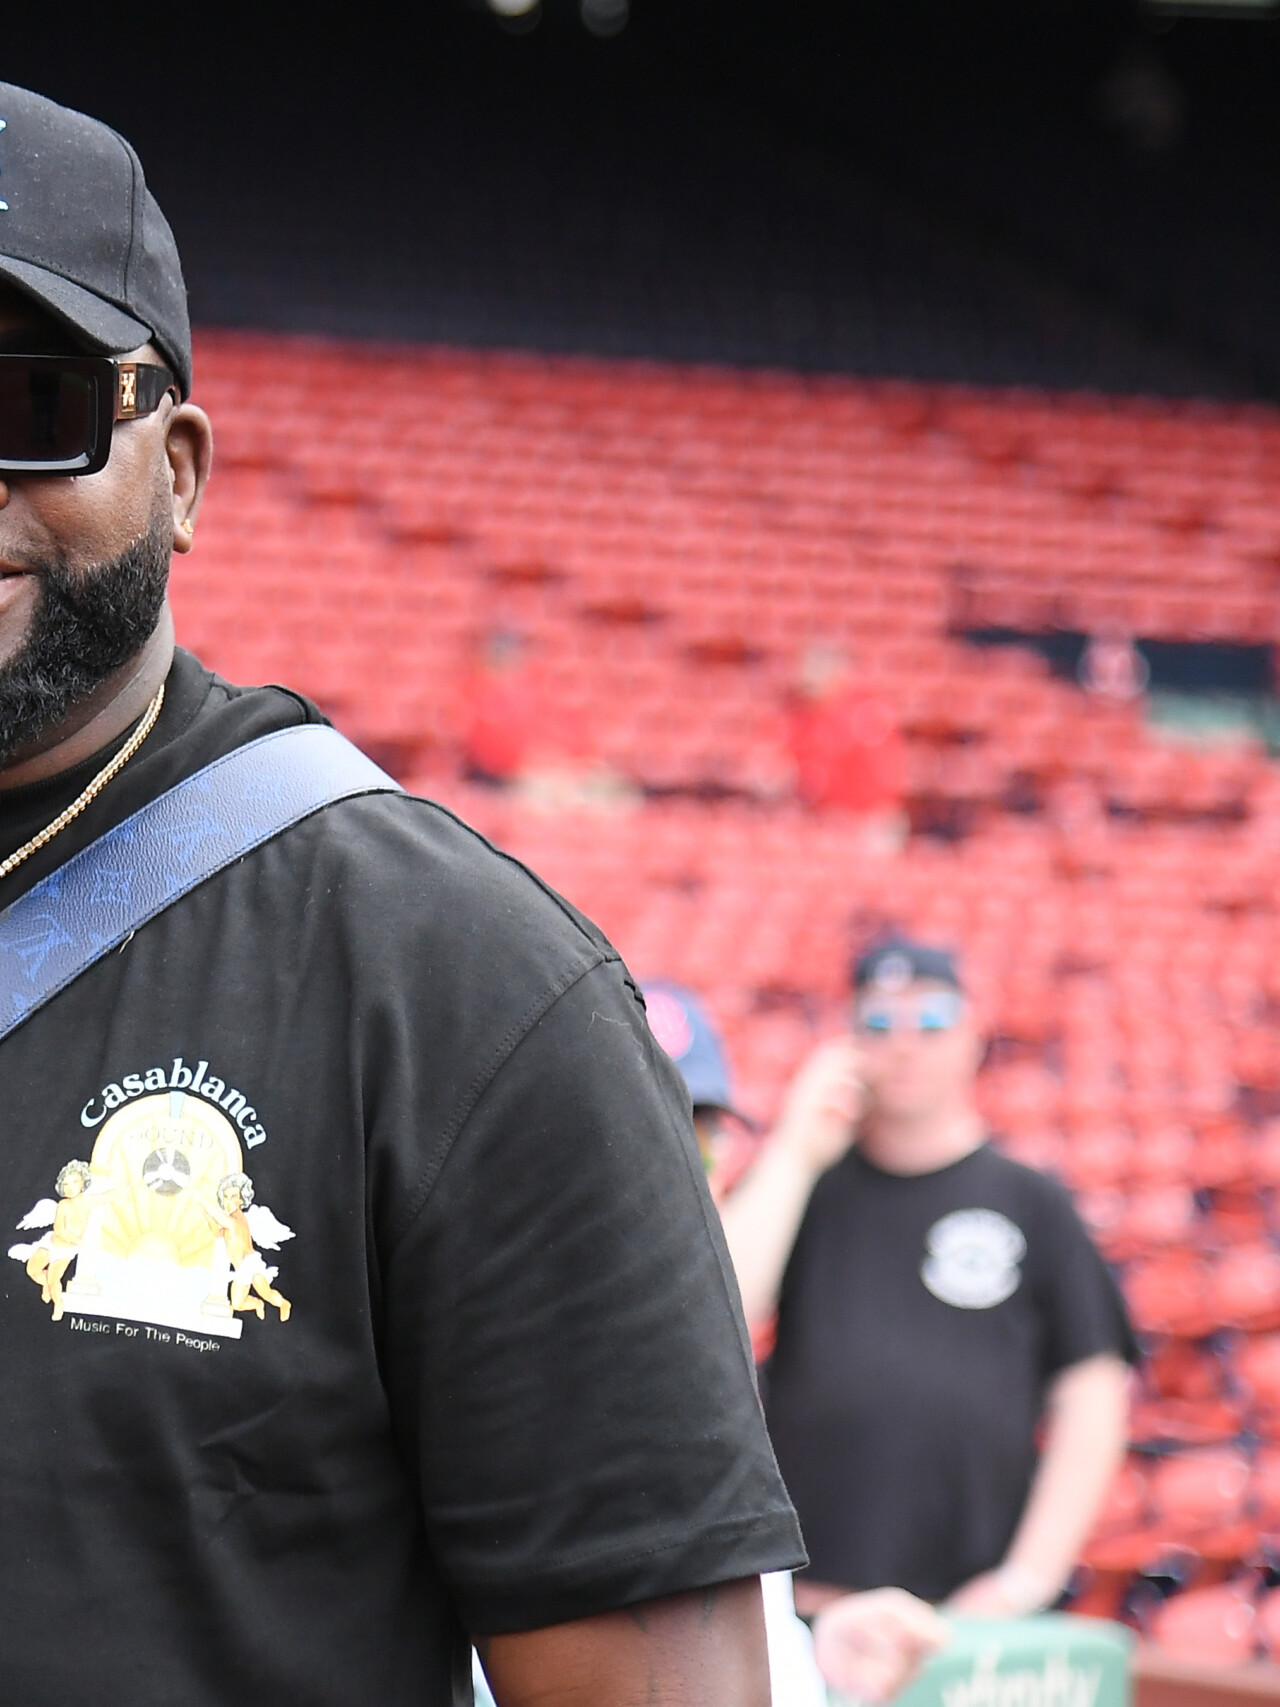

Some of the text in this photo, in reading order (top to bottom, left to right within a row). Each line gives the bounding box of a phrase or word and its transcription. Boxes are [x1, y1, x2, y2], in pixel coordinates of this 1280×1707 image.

[80, 1057, 267, 1150] Casablanca
[70, 1317, 220, 1352] Music For The People
